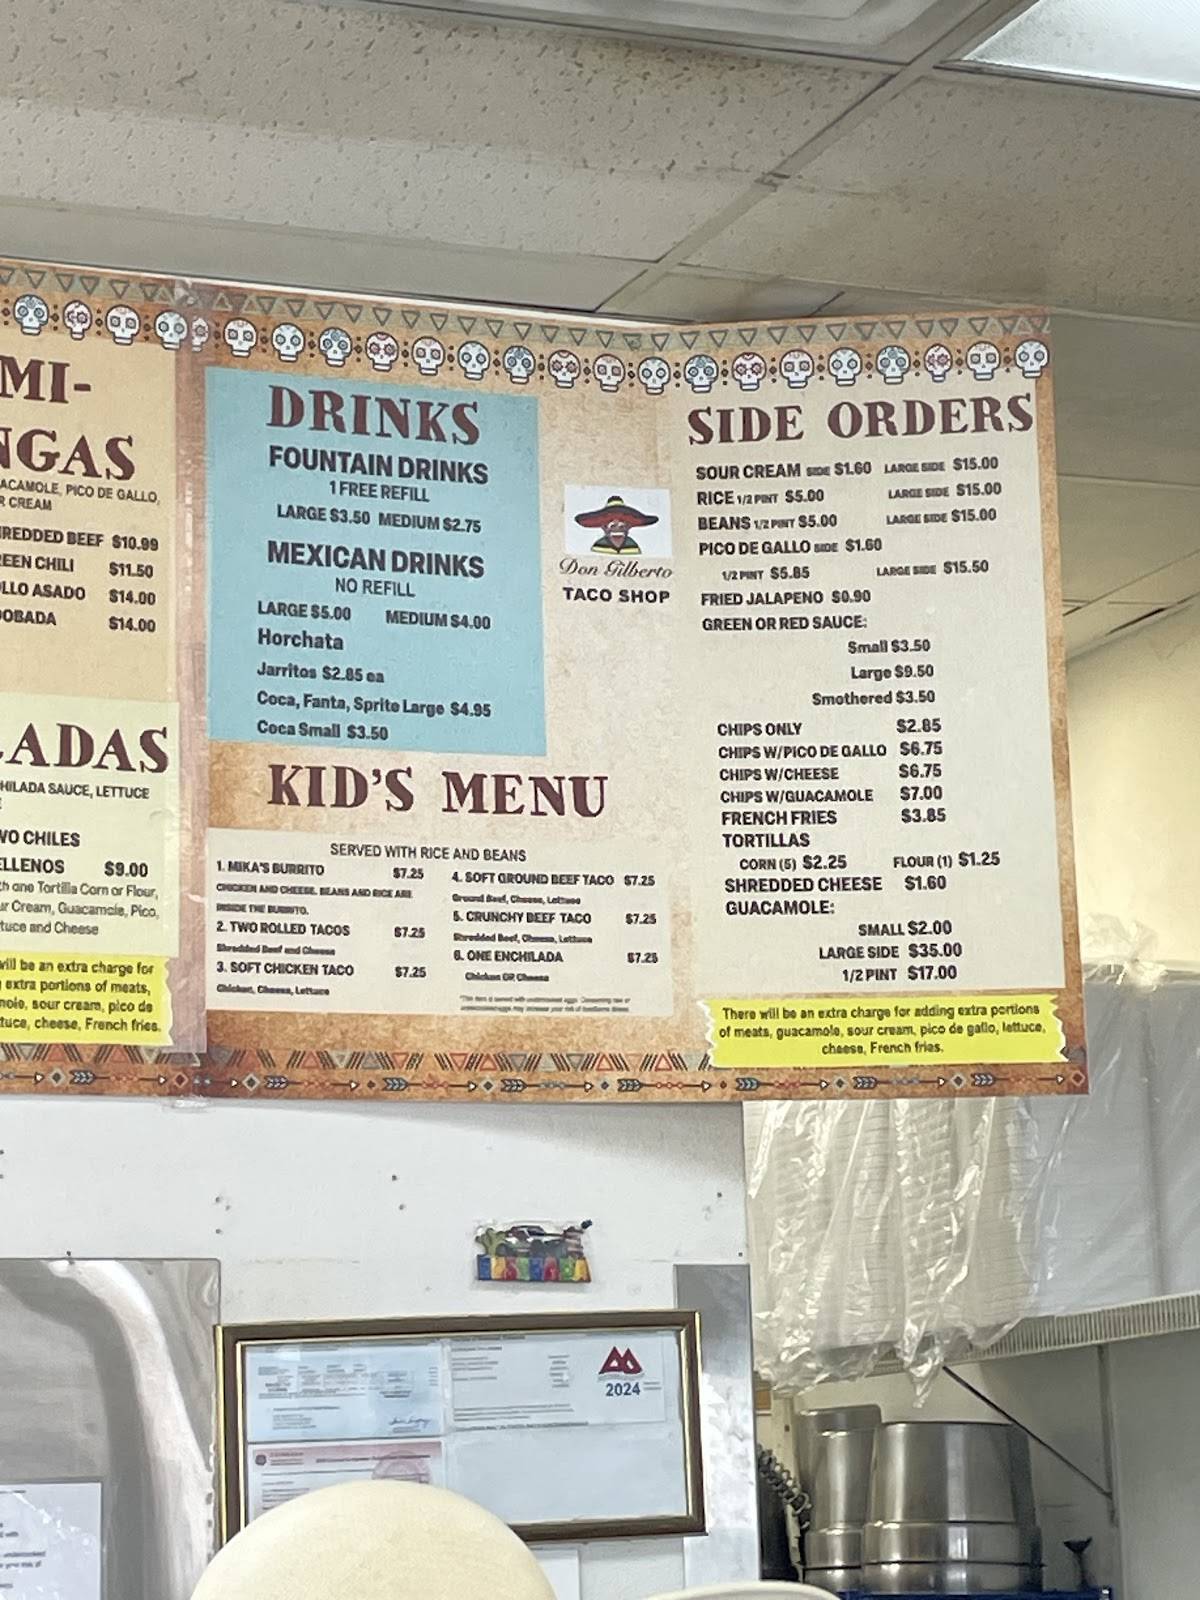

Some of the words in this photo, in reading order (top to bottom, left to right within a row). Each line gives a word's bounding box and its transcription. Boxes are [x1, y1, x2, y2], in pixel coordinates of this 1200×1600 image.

[266, 384, 480, 445] DRINKS
[688, 405, 804, 446] SIDE
[827, 393, 1034, 439] ORDERS
[269, 445, 392, 477] FOUNTAIN
[399, 456, 488, 484] DRINKS
[696, 466, 739, 480] SOUR
[743, 463, 800, 478] CREAM
[834, 462, 871, 475] $1.60
[953, 457, 998, 470] $15.00
[329, 481, 336, 494] 1
[339, 481, 377, 498] FREE
[381, 486, 430, 502] REFILL
[698, 491, 734, 505] RICE
[754, 494, 778, 504] PINT
[785, 490, 824, 502] $5.00
[889, 489, 923, 499] LARGE
[925, 487, 949, 497] SIDE
[956, 482, 1001, 496] $15.00
[9, 499, 51, 510] CREAM
[277, 504, 327, 521] LARGE
[330, 508, 370, 525] $3.50
[378, 512, 440, 530] MEDIUM
[443, 517, 481, 533] $2.75
[698, 516, 750, 530] BEANS
[798, 514, 837, 528] $5.00
[952, 509, 997, 522] $15.00
[67, 532, 103, 546] BEEF
[112, 535, 158, 550] $10.99
[699, 542, 735, 556] PICO
[739, 542, 758, 554] DE
[762, 540, 810, 554] GALLO
[846, 538, 882, 551] $1.60
[35, 558, 74, 572] CHILI
[109, 562, 153, 577] $11.50
[268, 540, 386, 571] MEXICAN
[391, 551, 484, 578] DRINKS
[560, 558, 600, 577] Don
[604, 560, 672, 579] Gilberto
[770, 566, 810, 579] $5.85
[944, 560, 989, 574] $15.50
[33, 584, 85, 600] ASADO
[109, 589, 155, 604] $14.00
[335, 578, 357, 593] NO
[363, 580, 415, 598] REFILL
[563, 587, 612, 602] TACO
[619, 589, 670, 604] SHOP
[701, 592, 742, 606] FRIED
[746, 591, 823, 605] JALAPENO
[832, 590, 871, 603] $0.90
[258, 601, 308, 618] LARGE
[311, 604, 351, 621] $5.00
[386, 610, 448, 628] MEDIUM
[450, 614, 491, 629] $4.00
[702, 618, 752, 631] GREEN
[756, 618, 777, 630] OR
[779, 617, 809, 629] RED
[812, 615, 867, 629] SAUCE:
[109, 616, 155, 632] $14.00
[258, 629, 343, 650] Horchata
[848, 640, 888, 654] Small
[891, 639, 930, 652] $3.50
[258, 662, 316, 679] Jarritos
[322, 666, 362, 682] $2.85
[366, 671, 384, 683] ea
[851, 665, 891, 681] Large
[895, 665, 934, 679] $9.50
[258, 691, 300, 709] Coca,
[303, 694, 350, 712] Fanta,
[354, 697, 400, 715] Sprite
[403, 700, 444, 717] Large
[450, 702, 491, 717] $4.95
[812, 691, 892, 706] Smothered
[896, 690, 935, 703] $3.50
[258, 720, 296, 736] Coca
[299, 722, 340, 738] Small
[347, 725, 388, 740] $3.50
[718, 724, 762, 736] CHIPS
[766, 723, 802, 735] ONLY
[897, 718, 941, 733] $2.85
[719, 746, 760, 759] CHIPS
[764, 746, 817, 758] W/PICO
[820, 745, 838, 757] DE
[842, 745, 887, 757] GALLO
[900, 742, 942, 756] $6.75
[720, 769, 762, 781] CHIPS
[765, 768, 839, 781] W/CHEESE
[899, 764, 942, 778] $6.75
[268, 764, 414, 812] KID'S
[442, 771, 608, 817] MENU
[721, 791, 762, 803] CHIPS
[766, 790, 873, 804] W/GUACAMOLE
[900, 786, 942, 801] $7.00
[722, 811, 787, 825] FRENCH
[791, 810, 837, 824] FRIES
[901, 809, 946, 823] $3.85
[23, 831, 80, 847] CHILES
[722, 833, 810, 848] TORTILLAS
[331, 843, 381, 857] SERVED
[385, 846, 416, 858] WITH
[420, 846, 449, 859] RICE
[453, 849, 479, 860] AND
[484, 850, 526, 861] BEANS
[740, 858, 777, 870] CORN
[802, 855, 847, 869] $2.25
[894, 856, 934, 868] FLOUR
[937, 855, 952, 868] (1)
[958, 851, 1000, 866] $1.25
[105, 861, 148, 877] $9.00
[228, 862, 270, 873] MIKA'S
[273, 863, 324, 875] BURRITO
[393, 868, 423, 879] $7.25
[725, 878, 814, 893] SHREDDED
[818, 877, 882, 891] CHEESE
[905, 876, 946, 891] $1.60
[726, 901, 834, 915] GUACAMOLE:
[230, 922, 257, 933] TWO
[260, 923, 306, 935] ROLLED
[311, 925, 350, 936] TACOS
[394, 927, 425, 938] $7.25
[858, 923, 905, 936] SMALL
[908, 920, 952, 936] $2.00
[819, 946, 865, 960] LARGE
[867, 946, 899, 958] SIDE
[908, 943, 961, 958] $35.00
[231, 963, 261, 974] SOFT
[264, 963, 318, 975] CHICKEN
[322, 964, 354, 975] TACO
[395, 967, 426, 977] $7.25
[866, 969, 897, 981] PINT
[908, 966, 957, 981] $17.00
[723, 1008, 756, 1020] There
[760, 1008, 779, 1019] will
[783, 1007, 797, 1019] be
[800, 1008, 815, 1019] an
[818, 1007, 848, 1019] extra
[851, 1007, 891, 1021] charge
[894, 1006, 910, 1017] for
[914, 1005, 954, 1020] adding
[958, 1005, 987, 1016] extra
[991, 1004, 1040, 1018] portions
[35, 1018, 81, 1031] cheese,
[86, 1019, 128, 1031] French
[132, 1020, 161, 1033] fries.
[822, 1043, 866, 1056] cheese,
[870, 1041, 912, 1054] French
[915, 1041, 944, 1053] fries.
[605, 1382, 641, 1397] 2024
